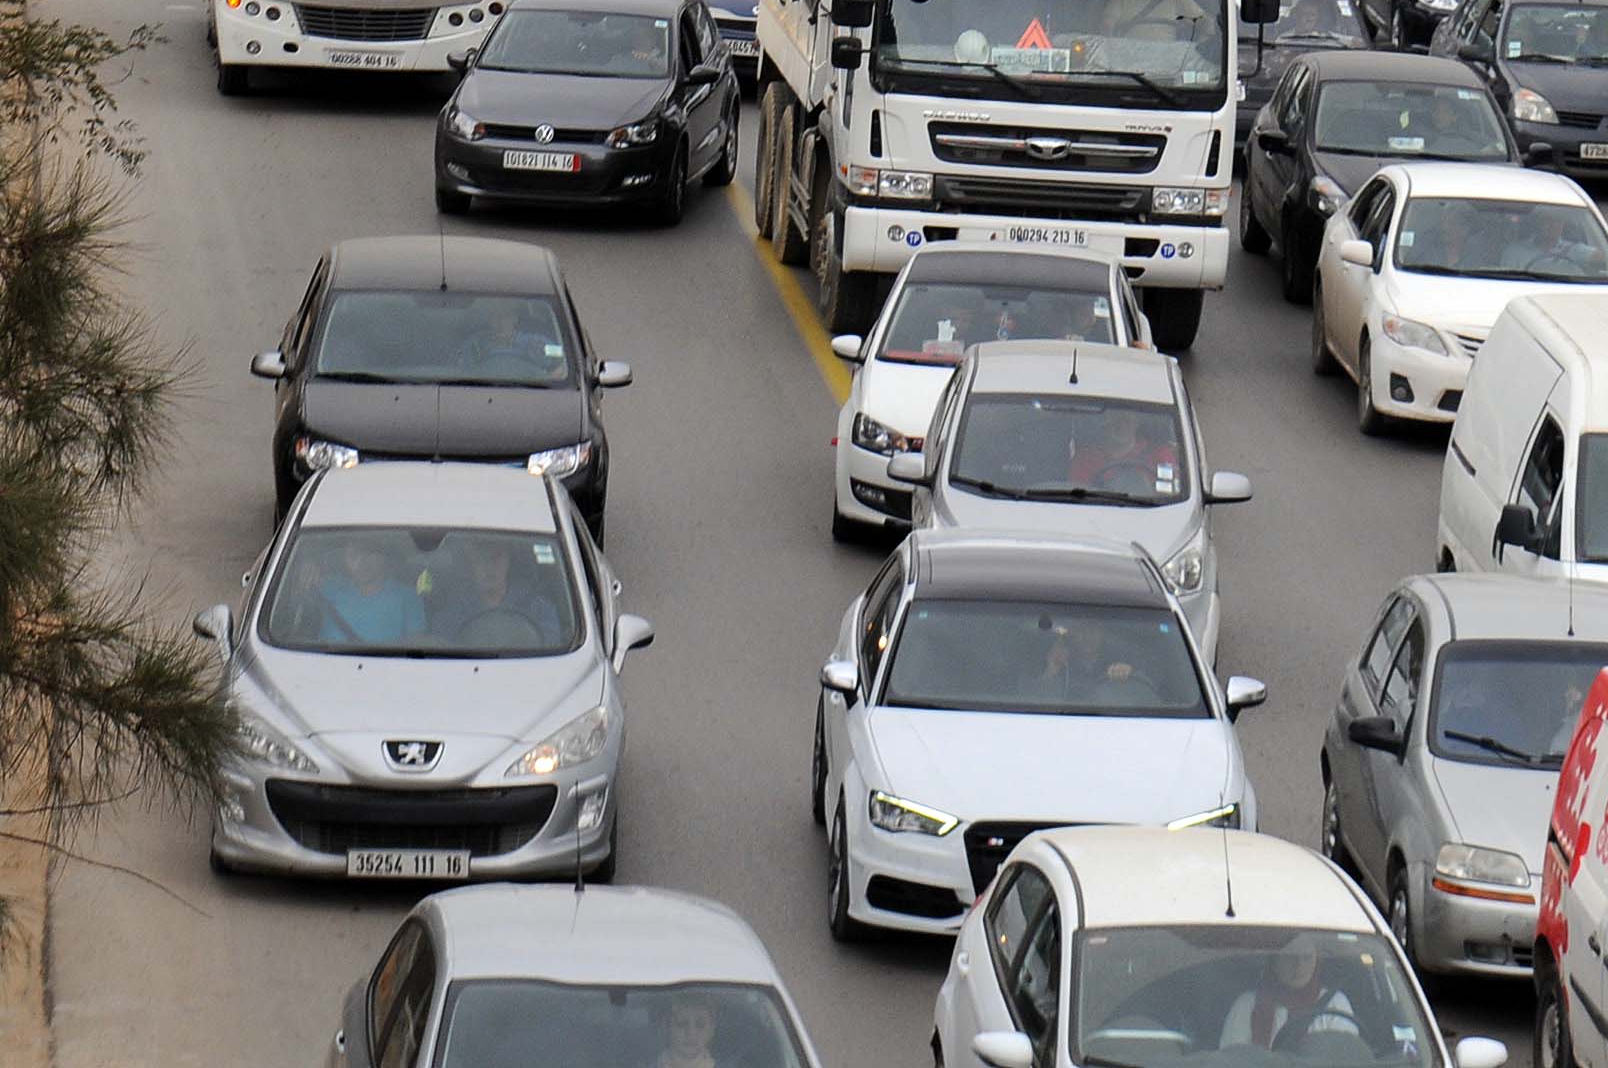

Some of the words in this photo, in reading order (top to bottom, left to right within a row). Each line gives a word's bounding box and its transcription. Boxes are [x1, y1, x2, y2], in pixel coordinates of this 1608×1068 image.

[506, 151, 538, 167] 101821
[542, 153, 558, 169] 114
[562, 155, 573, 169] 16
[1052, 229, 1070, 244] 213
[1074, 229, 1085, 245] 16
[355, 852, 402, 874] 35254
[413, 854, 435, 875] 111
[446, 854, 462, 877] 16
